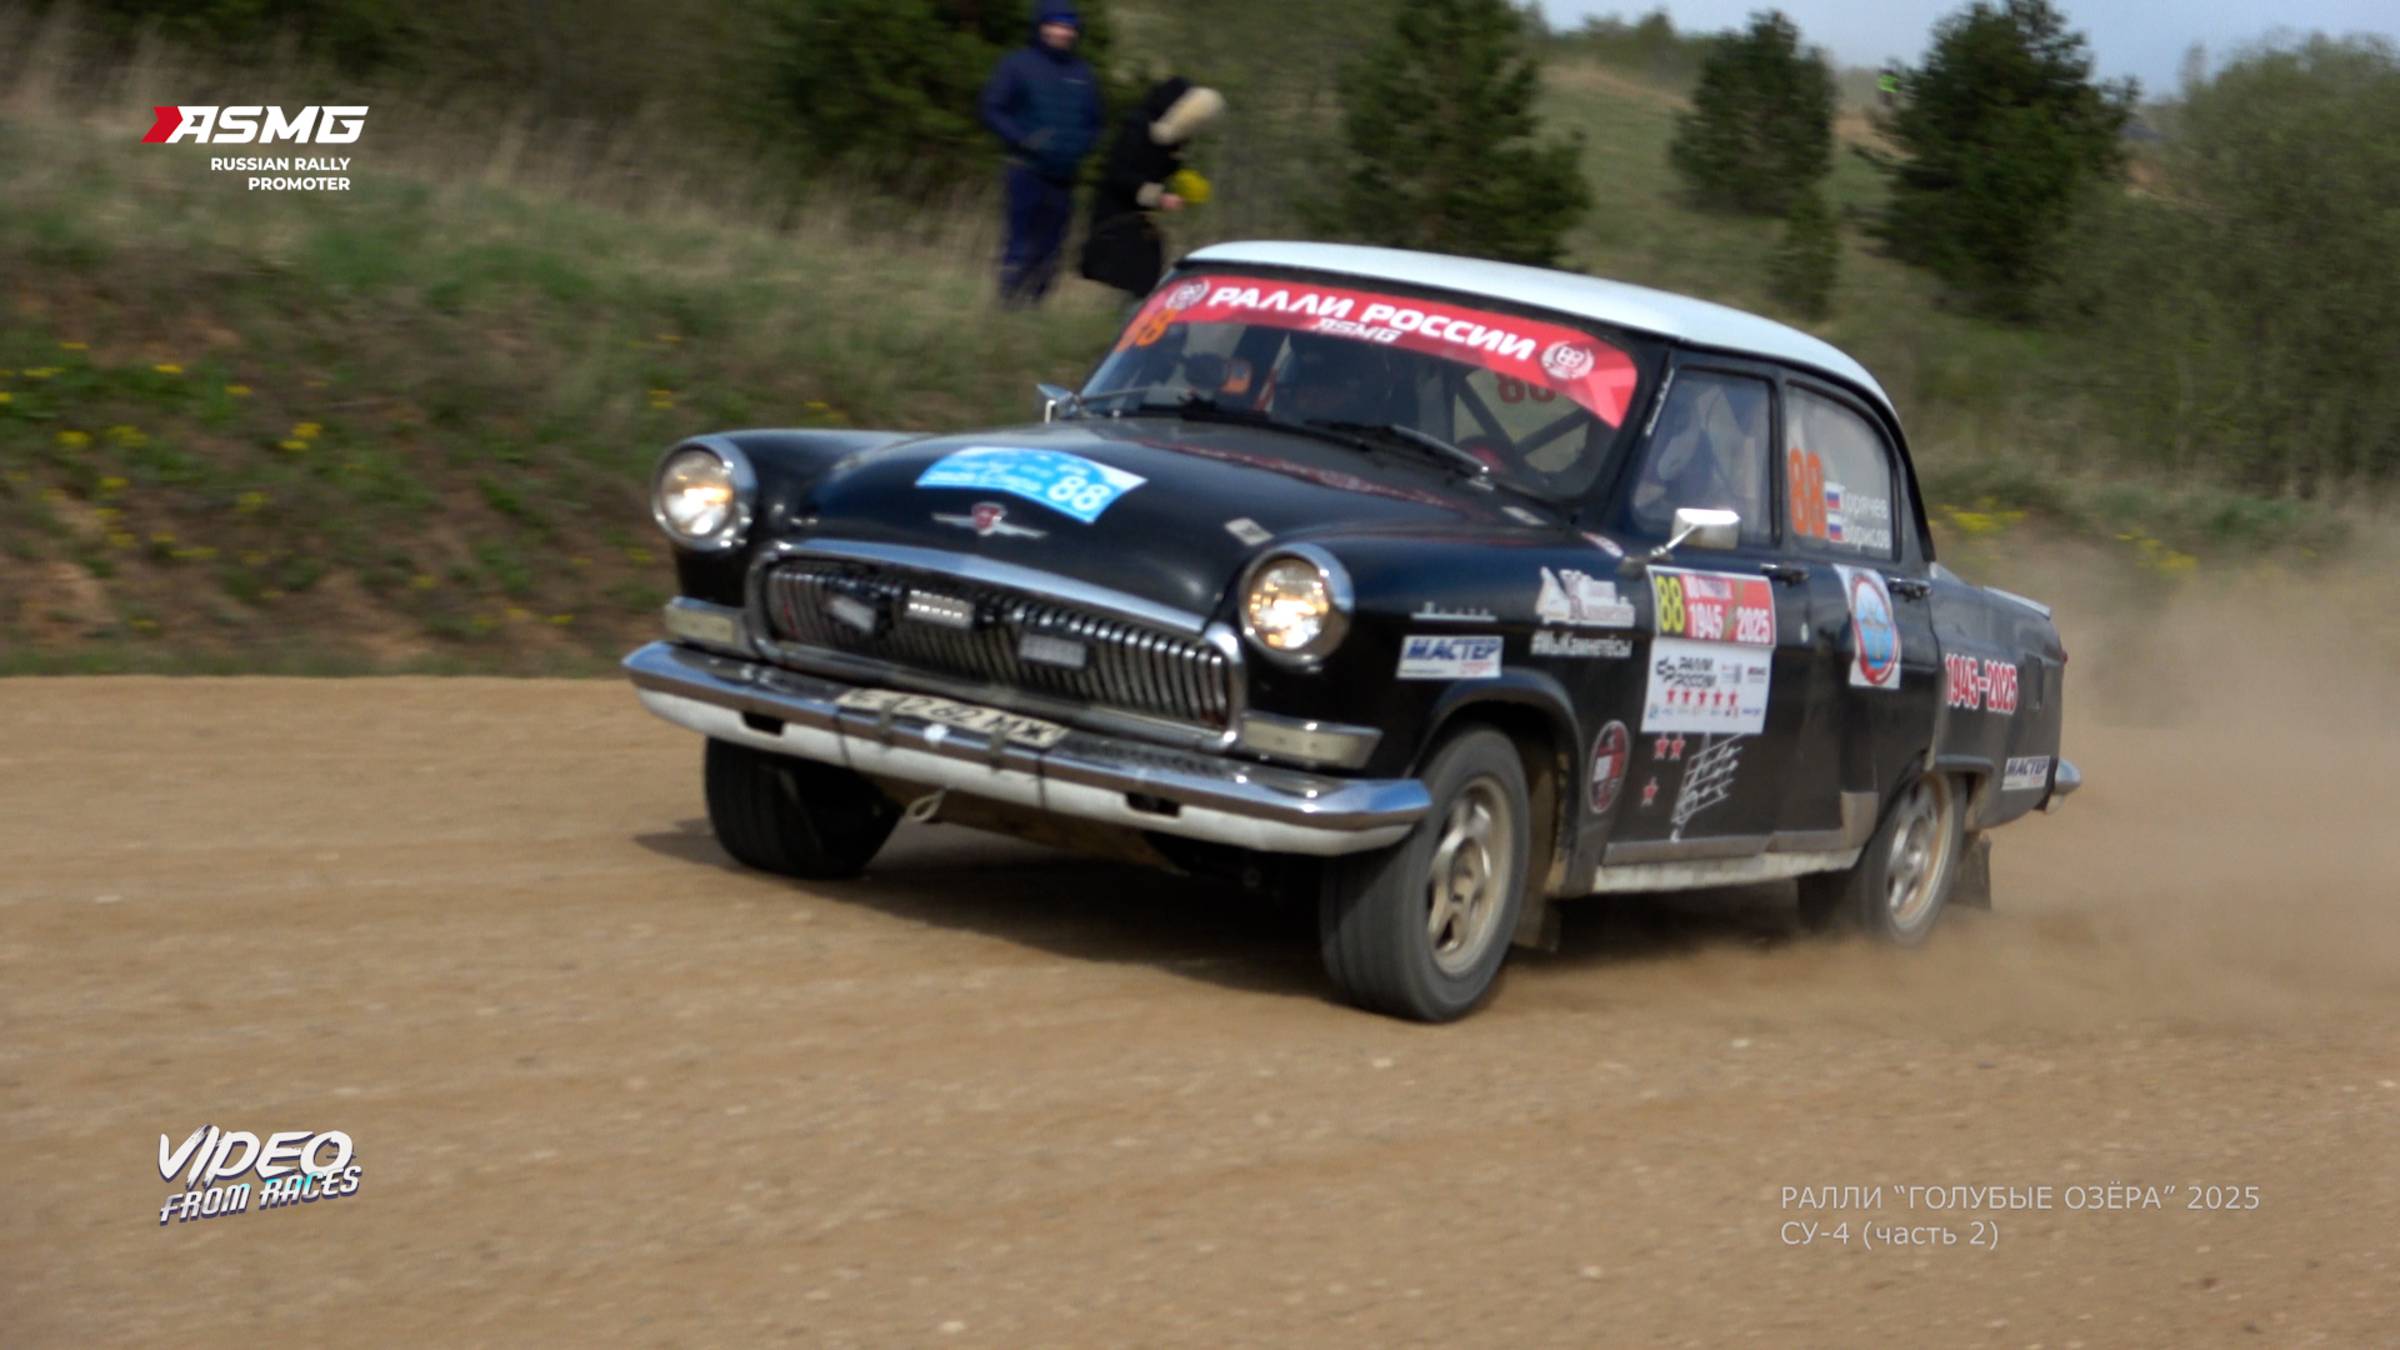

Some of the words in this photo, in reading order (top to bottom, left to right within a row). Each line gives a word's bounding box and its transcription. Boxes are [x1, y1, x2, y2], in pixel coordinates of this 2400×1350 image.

[1207, 286, 1356, 320] РАЛЛИ
[1361, 303, 1536, 361] РОССИИ
[1049, 475, 1110, 510] 88
[1788, 448, 1826, 538] 88
[1655, 575, 1685, 633] 88
[1688, 603, 1724, 639] 1945
[1736, 607, 1771, 644] 2025
[1407, 639, 1500, 660] МАСТЕР
[1945, 654, 2019, 716] 1945-2025
